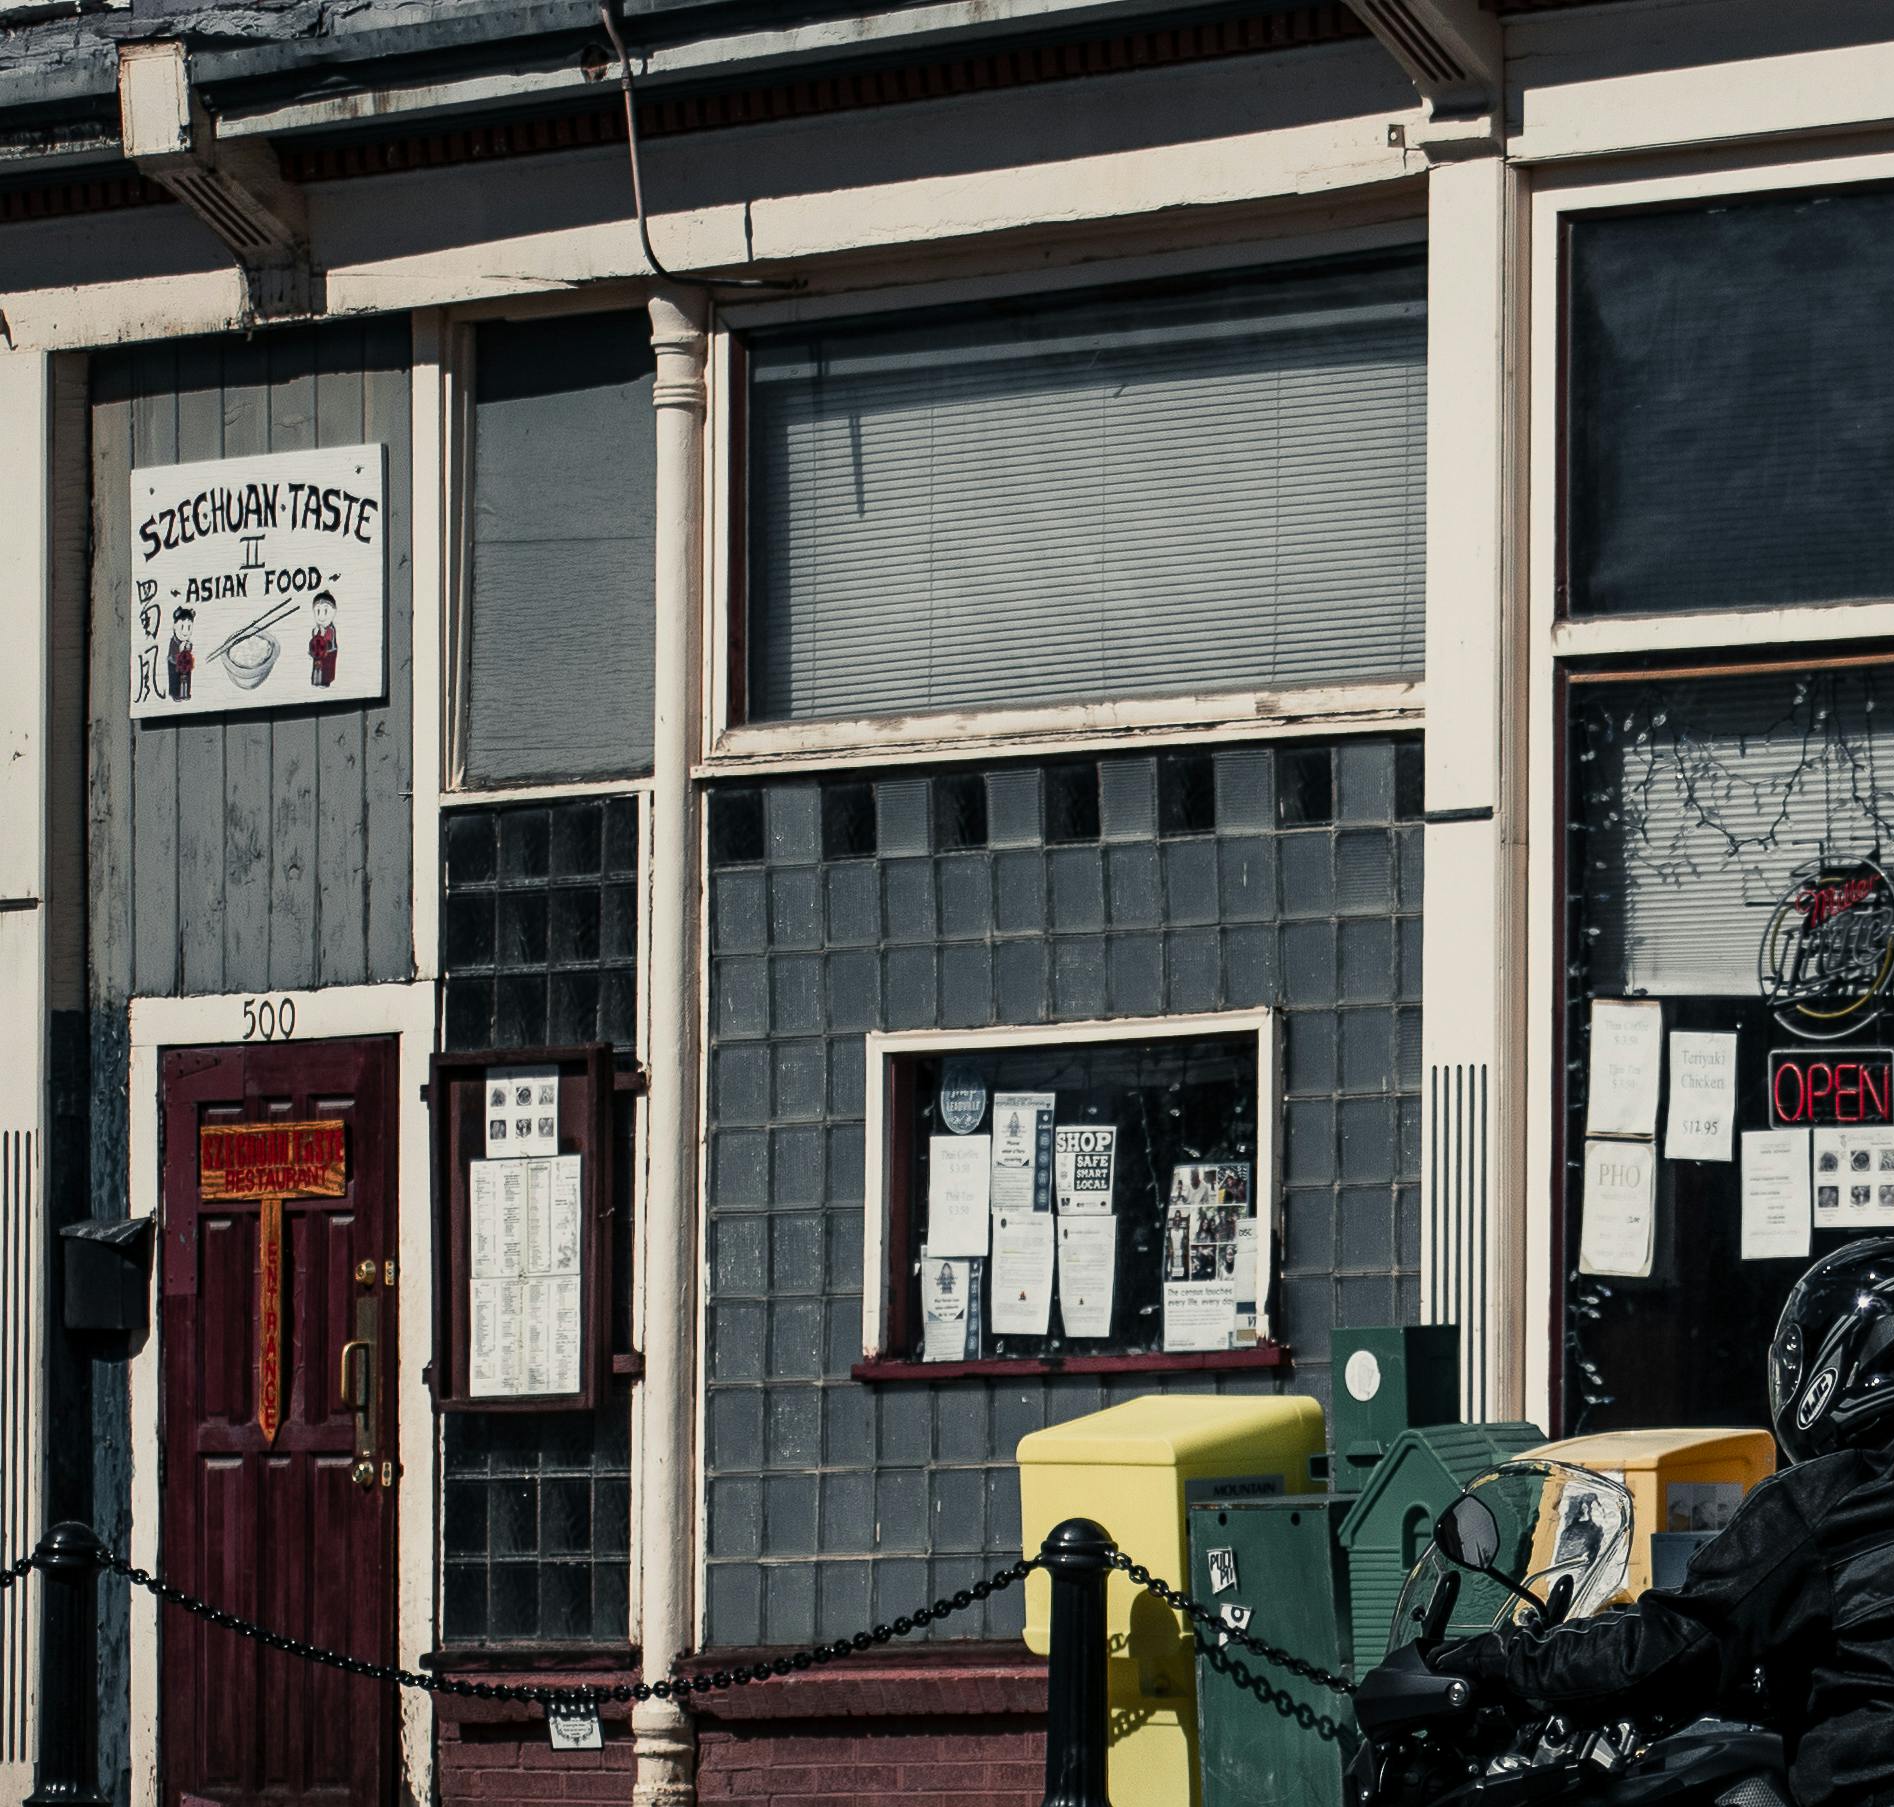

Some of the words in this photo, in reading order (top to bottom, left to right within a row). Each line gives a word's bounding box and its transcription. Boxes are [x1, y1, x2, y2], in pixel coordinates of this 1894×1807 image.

[139, 484, 279, 562] SZECHUAN
[288, 483, 378, 544] TASTE
[239, 534, 266, 570] II
[186, 573, 248, 603] ASIAN
[264, 567, 322, 596] FOOD
[1794, 873, 1882, 928] Miller
[243, 998, 296, 1041] 500
[1681, 1050, 1726, 1069] Teriyaki
[1681, 1073, 1726, 1090] Chicken
[1774, 1062, 1891, 1121] OPEN
[1057, 1131, 1111, 1153] SHOP
[1076, 1169, 1107, 1178] SMART
[1077, 1156, 1108, 1167] SAFE
[225, 1167, 327, 1192] RESTAURANT
[1076, 1180, 1107, 1189] LOCAL
[1599, 1163, 1640, 1188] PHO
[264, 1242, 278, 1429] ENTRANCE
[1213, 1483, 1276, 1496] MOUNTAIN
